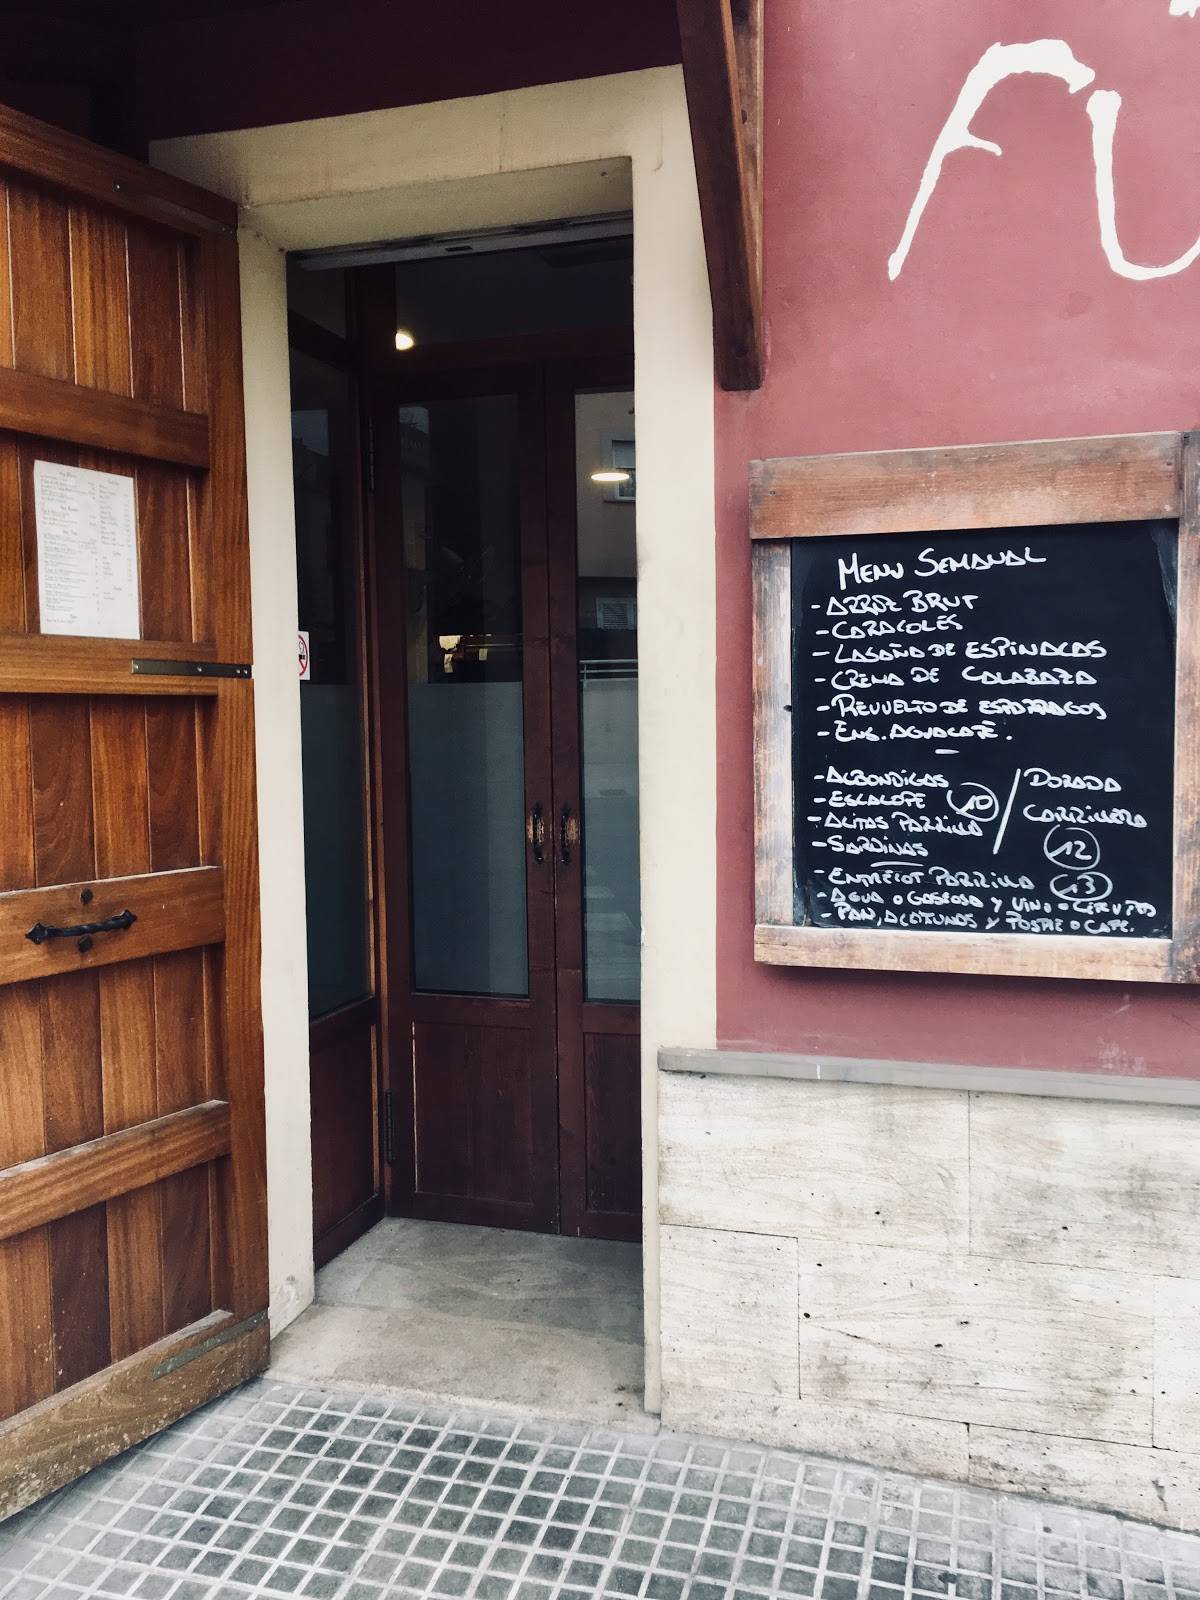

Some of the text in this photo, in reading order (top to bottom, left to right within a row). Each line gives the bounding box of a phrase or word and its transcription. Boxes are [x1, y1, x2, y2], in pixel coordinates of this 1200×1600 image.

[837, 546, 1047, 591] MENU SEMANAL
[902, 589, 979, 613] BRUT
[927, 642, 956, 657] DE
[910, 666, 940, 683] DE
[961, 665, 1098, 685] CALABAZA
[939, 698, 969, 715] DE
[1023, 767, 1123, 793] DORADA
